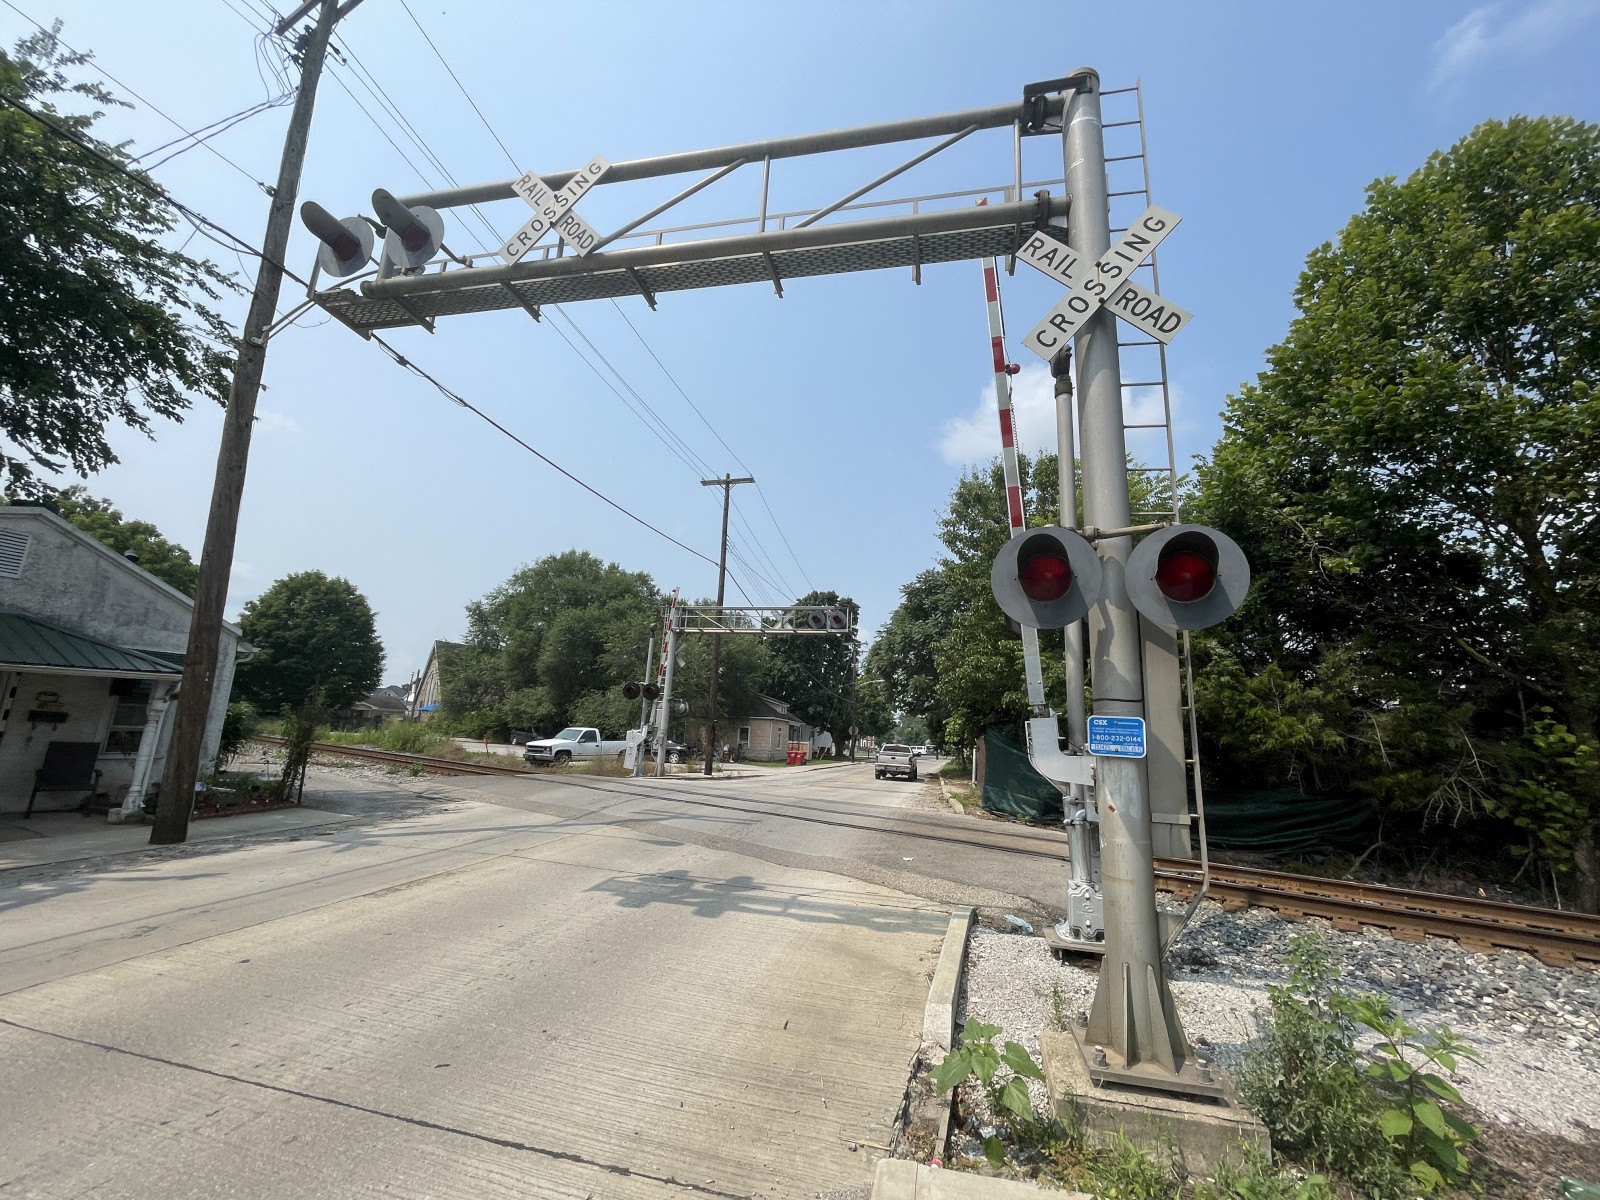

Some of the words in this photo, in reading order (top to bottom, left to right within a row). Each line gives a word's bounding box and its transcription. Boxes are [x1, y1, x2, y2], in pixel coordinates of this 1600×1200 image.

[506, 163, 602, 257] CROSSING
[516, 174, 547, 207] RAIL
[559, 215, 594, 250] ROAD
[1022, 237, 1078, 280] RAIL
[1114, 287, 1182, 334] ROAD
[1036, 216, 1166, 348] CROSSING
[1092, 734, 1142, 743] 1-800-232-0144
